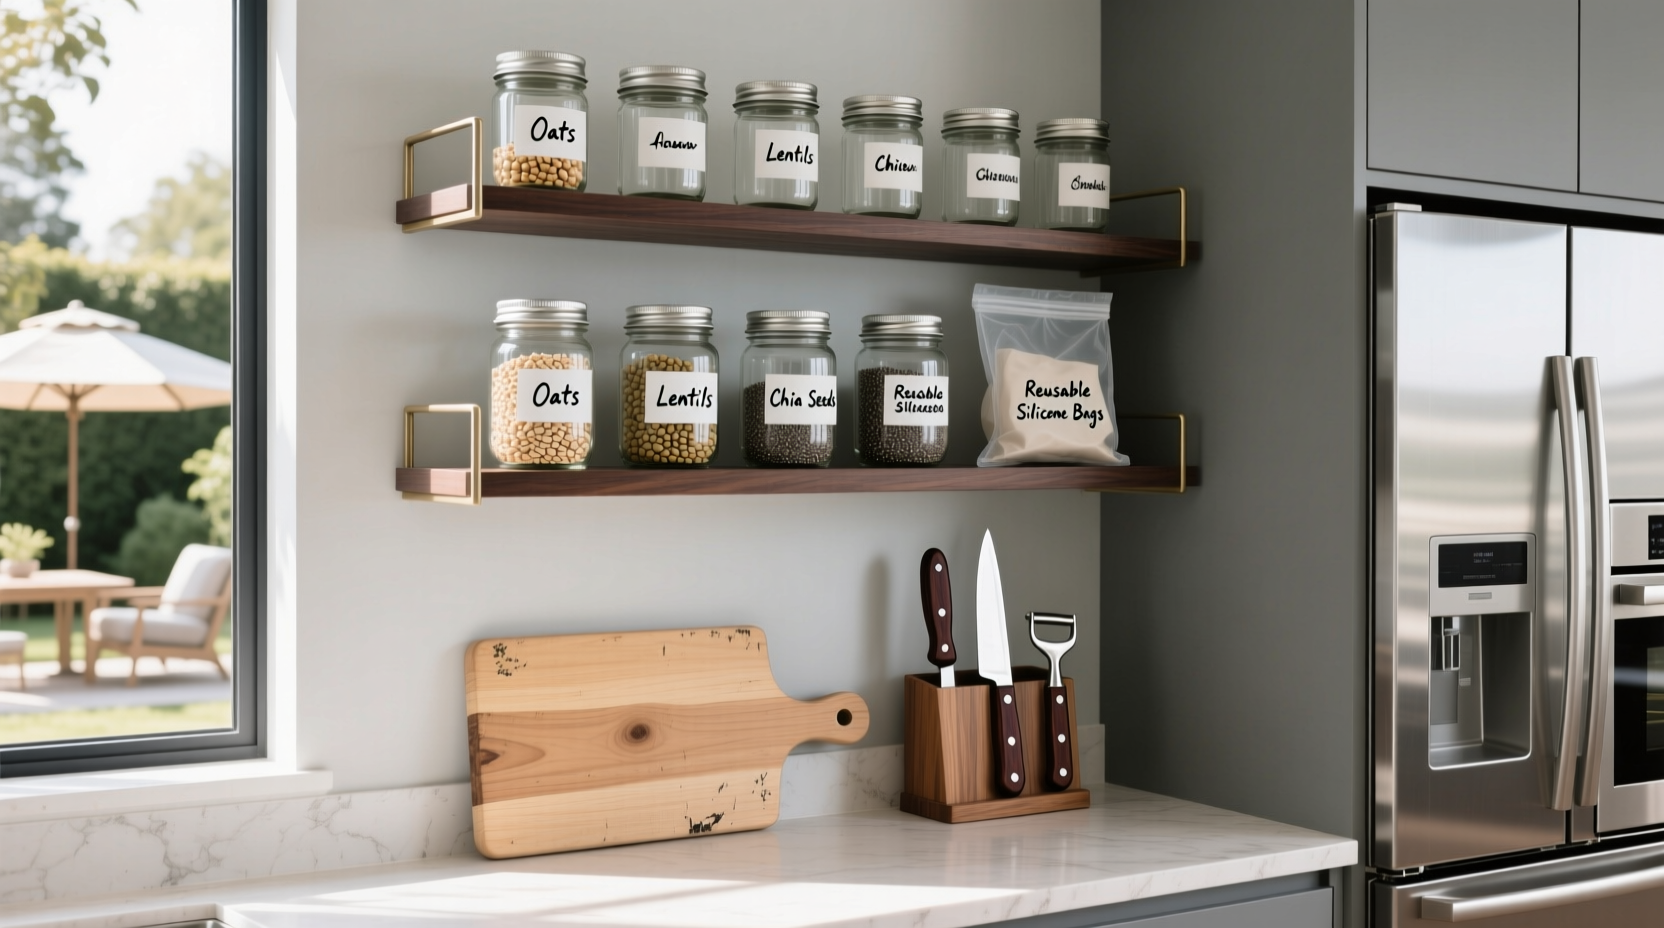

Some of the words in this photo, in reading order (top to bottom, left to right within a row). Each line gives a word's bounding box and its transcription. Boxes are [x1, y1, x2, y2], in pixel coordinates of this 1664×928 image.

[530, 115, 576, 143] Oats
[765, 142, 814, 165] Lentils
[532, 382, 580, 408] Oats
[656, 384, 713, 409] Lentils
[769, 386, 803, 408] Chia
[807, 389, 836, 408] Seeds
[1025, 379, 1091, 398] Reusable
[1016, 402, 1069, 421] Silicone
[1072, 402, 1104, 429] Bags
